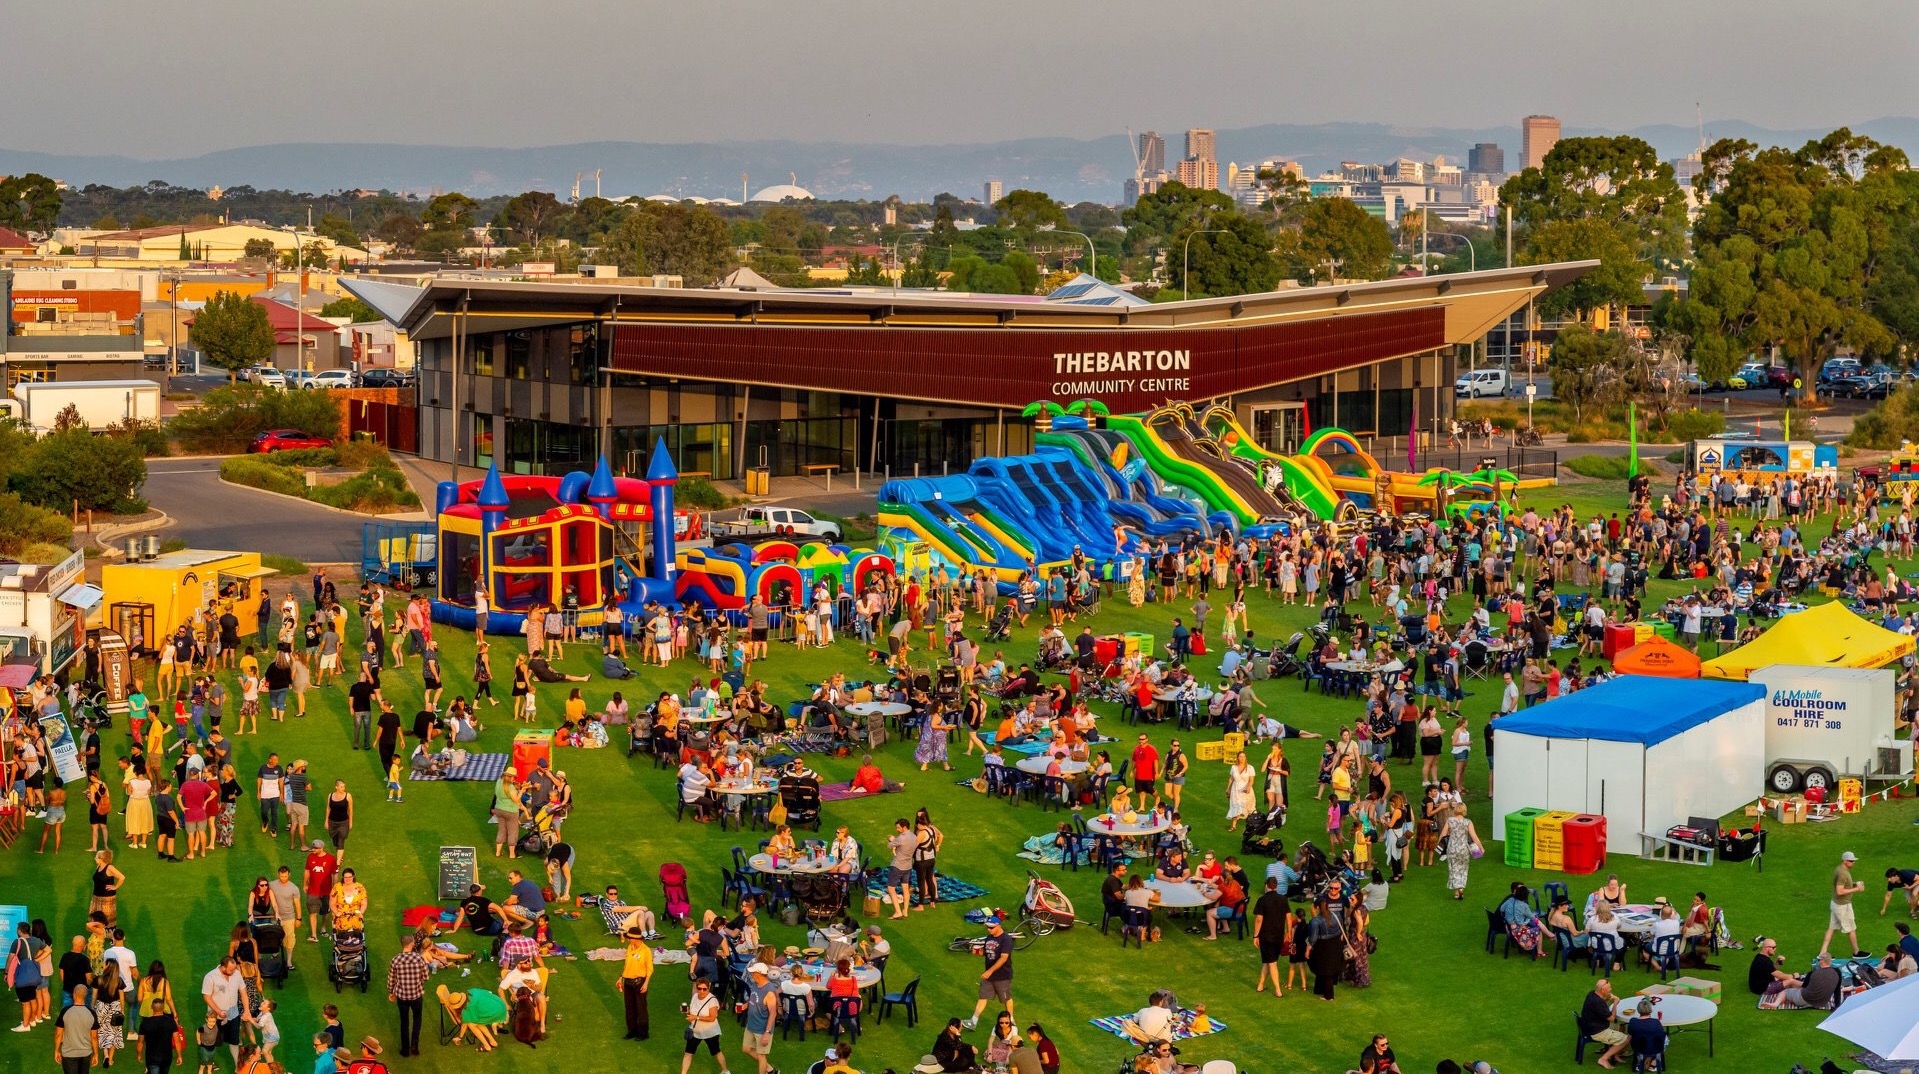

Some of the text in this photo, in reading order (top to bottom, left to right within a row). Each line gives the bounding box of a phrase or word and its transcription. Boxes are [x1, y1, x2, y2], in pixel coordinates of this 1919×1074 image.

[1053, 350, 1190, 374] THEBARTON
[1052, 378, 1190, 396] COMMUNITY CENTRE
[112, 663, 121, 700] COFFEE
[1773, 690, 1822, 700] A1 Mobile
[1773, 698, 1846, 710] COOLROOM
[1794, 710, 1824, 719] HIRE
[1778, 718, 1841, 729] 0417 871 308
[55, 745, 73, 755] PAELLA
